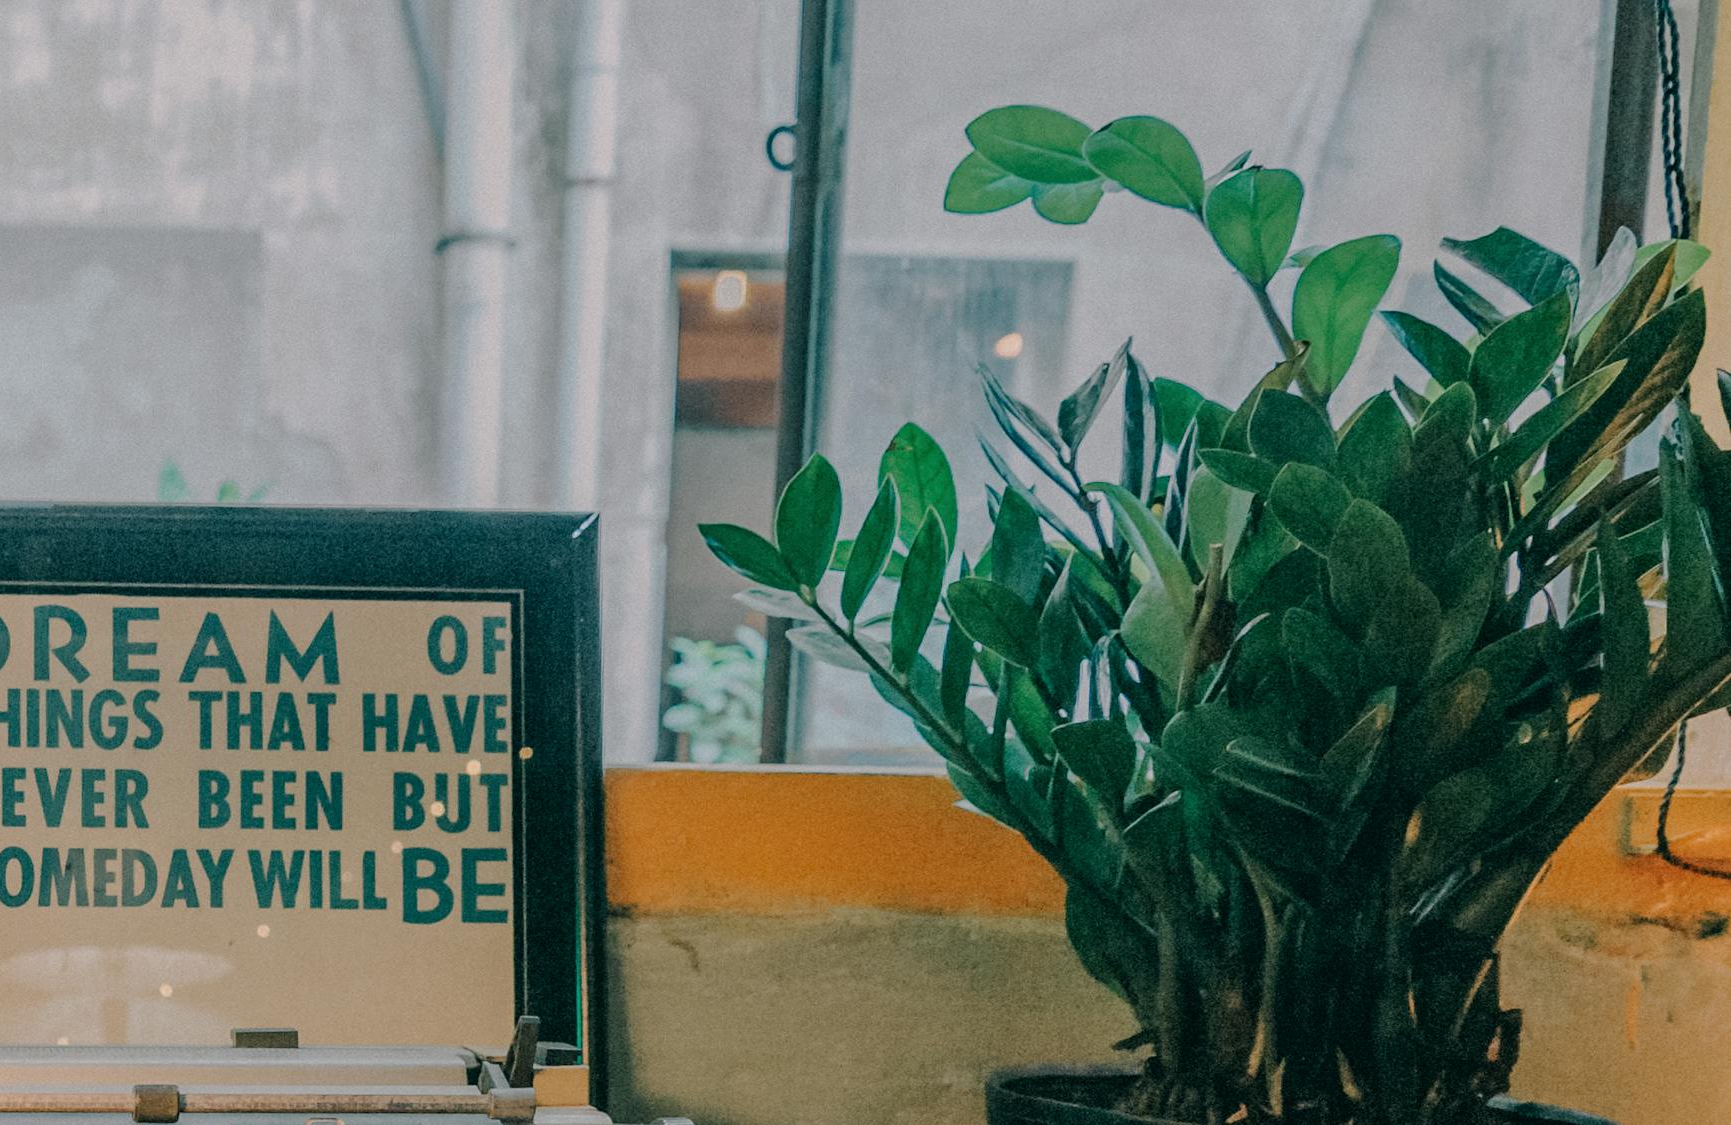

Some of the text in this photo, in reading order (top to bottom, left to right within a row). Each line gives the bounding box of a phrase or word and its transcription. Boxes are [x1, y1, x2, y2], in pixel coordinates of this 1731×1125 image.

[426, 615, 508, 676] OF
[188, 690, 337, 753] THAT
[362, 693, 509, 755] HAVE
[198, 769, 344, 831] BEEN
[392, 772, 509, 834] BUT
[248, 849, 388, 911] WILL
[401, 847, 509, 925] BE
